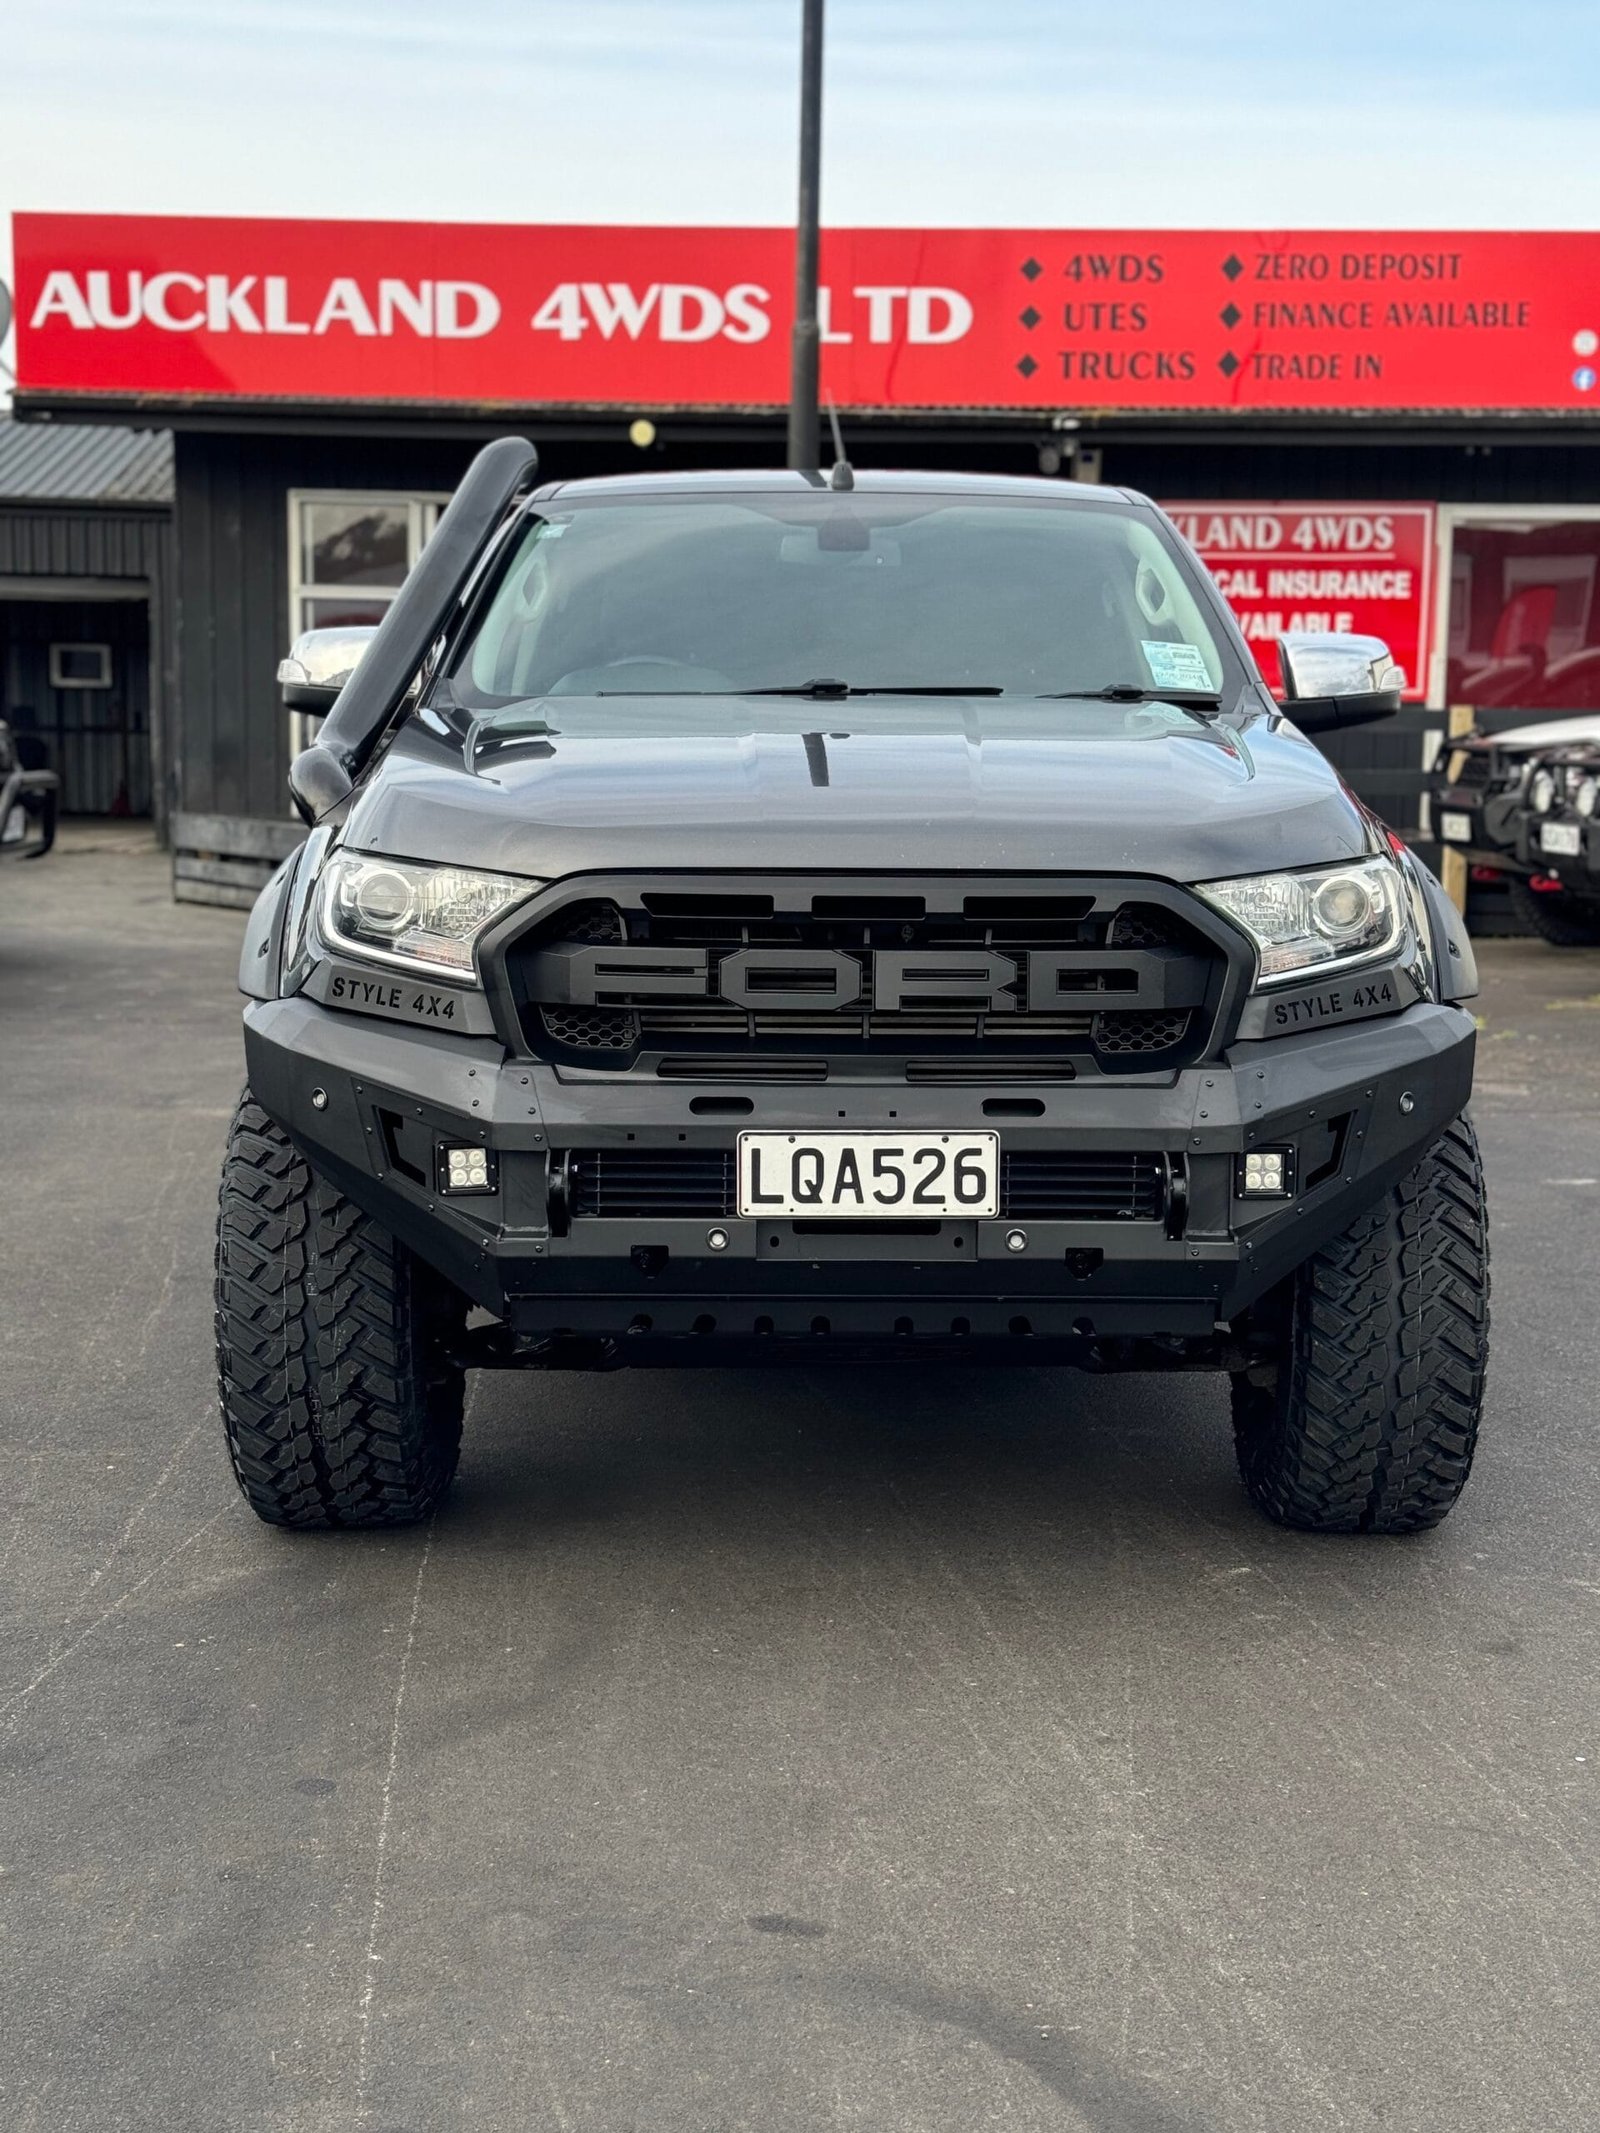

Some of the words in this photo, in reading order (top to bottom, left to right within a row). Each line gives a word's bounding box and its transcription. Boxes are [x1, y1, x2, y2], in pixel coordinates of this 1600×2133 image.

[1064, 254, 1164, 283] 4WDS
[1254, 253, 1330, 280] ZERO
[1340, 253, 1462, 280] DEPOSIT
[30, 270, 500, 338] AUCKLAND
[531, 282, 771, 343] 4WDS
[817, 286, 974, 344] LTD
[1064, 303, 1147, 331] UTES
[1253, 303, 1373, 328] FINANCE
[1384, 302, 1530, 328] AVAILABLE
[1059, 352, 1196, 380] TRUCKS
[1252, 354, 1341, 380] TRADE
[1354, 354, 1382, 379] IN
[1292, 516, 1394, 550] 4WDS
[1267, 570, 1411, 599] INSURANCE
[560, 945, 1168, 1012] FORD
[331, 976, 402, 1008] STYLE
[412, 993, 455, 1020] 4X4
[1274, 993, 1343, 1025] STYLE
[1353, 983, 1392, 1008] 4X4
[751, 1147, 987, 1205] LQA526
